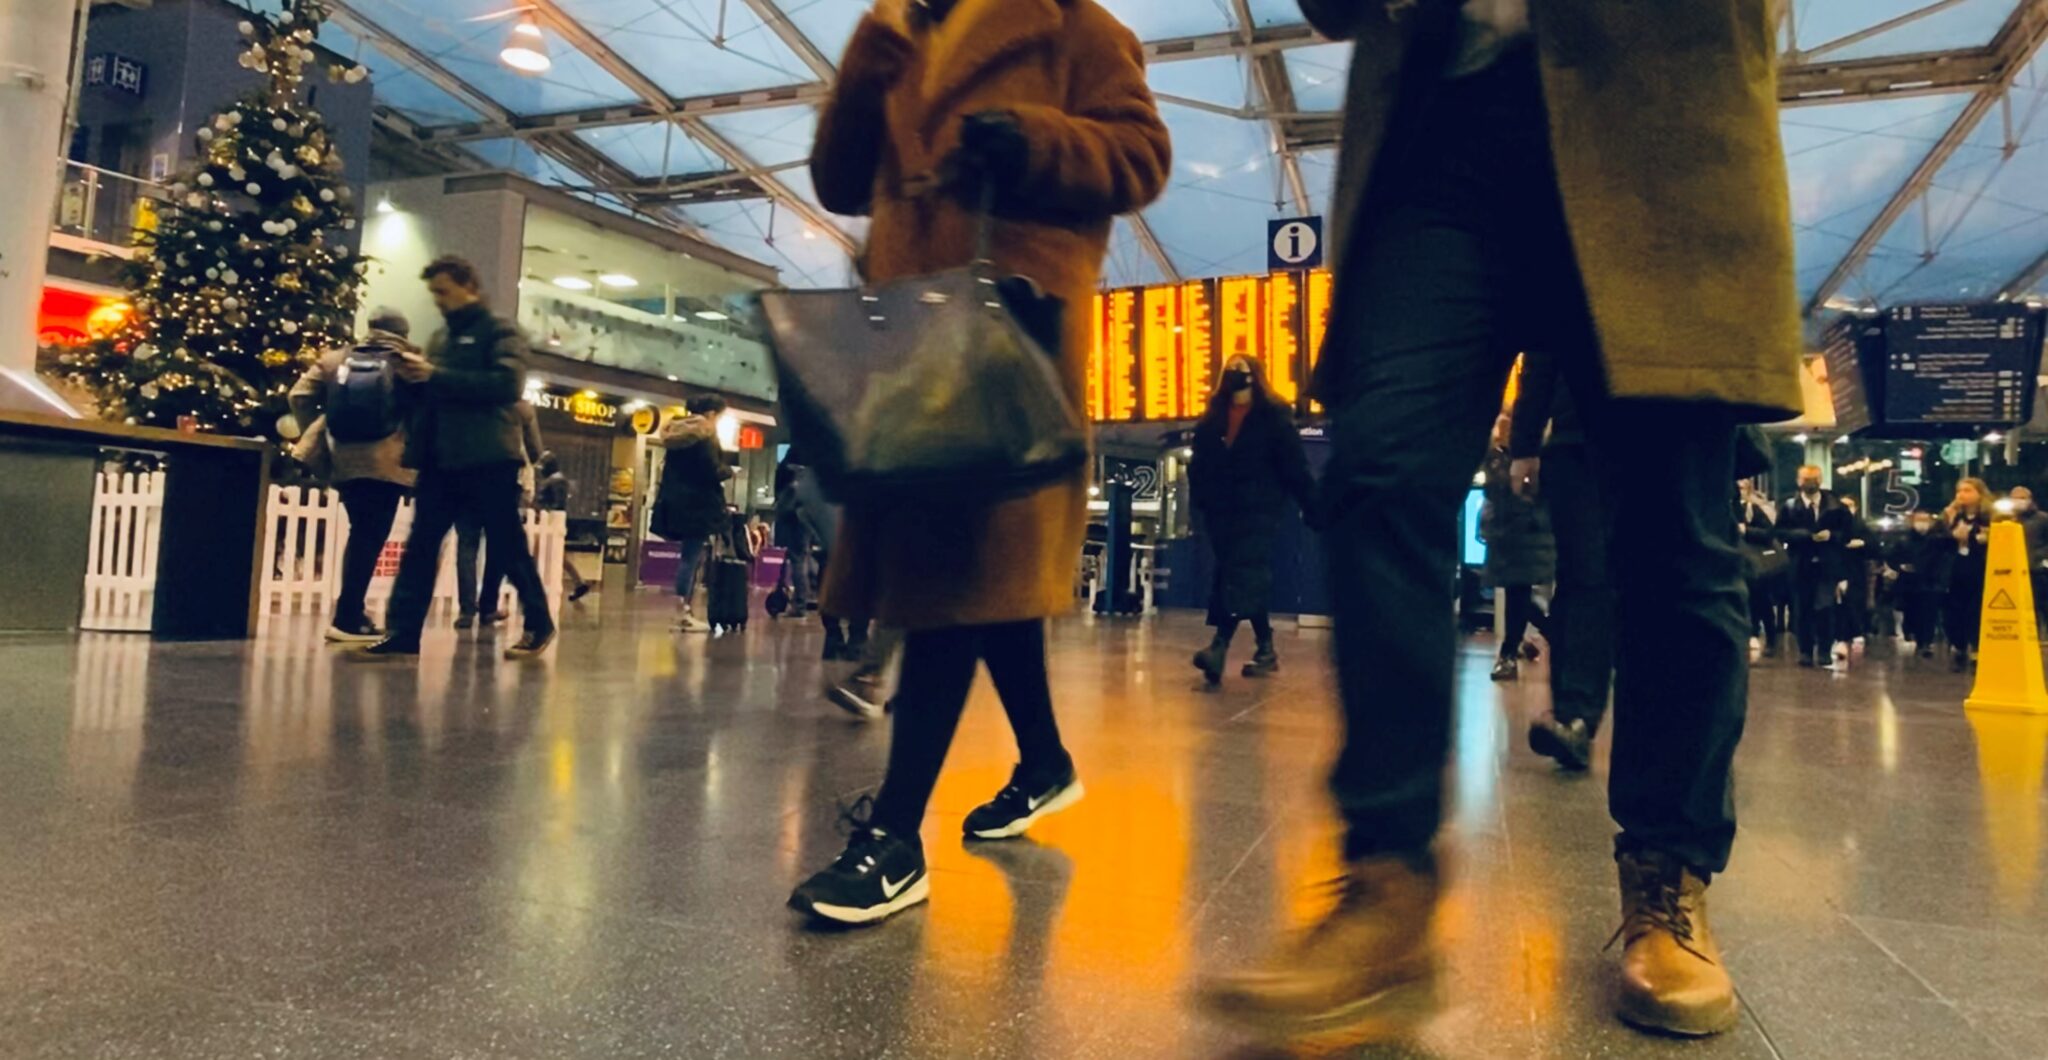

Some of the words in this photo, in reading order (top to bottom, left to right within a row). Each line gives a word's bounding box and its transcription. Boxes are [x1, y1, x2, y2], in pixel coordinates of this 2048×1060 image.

[1288, 225, 1301, 259] i
[575, 400, 617, 419] SHOP
[1131, 465, 1157, 501] 2
[1884, 469, 1920, 516] 5
